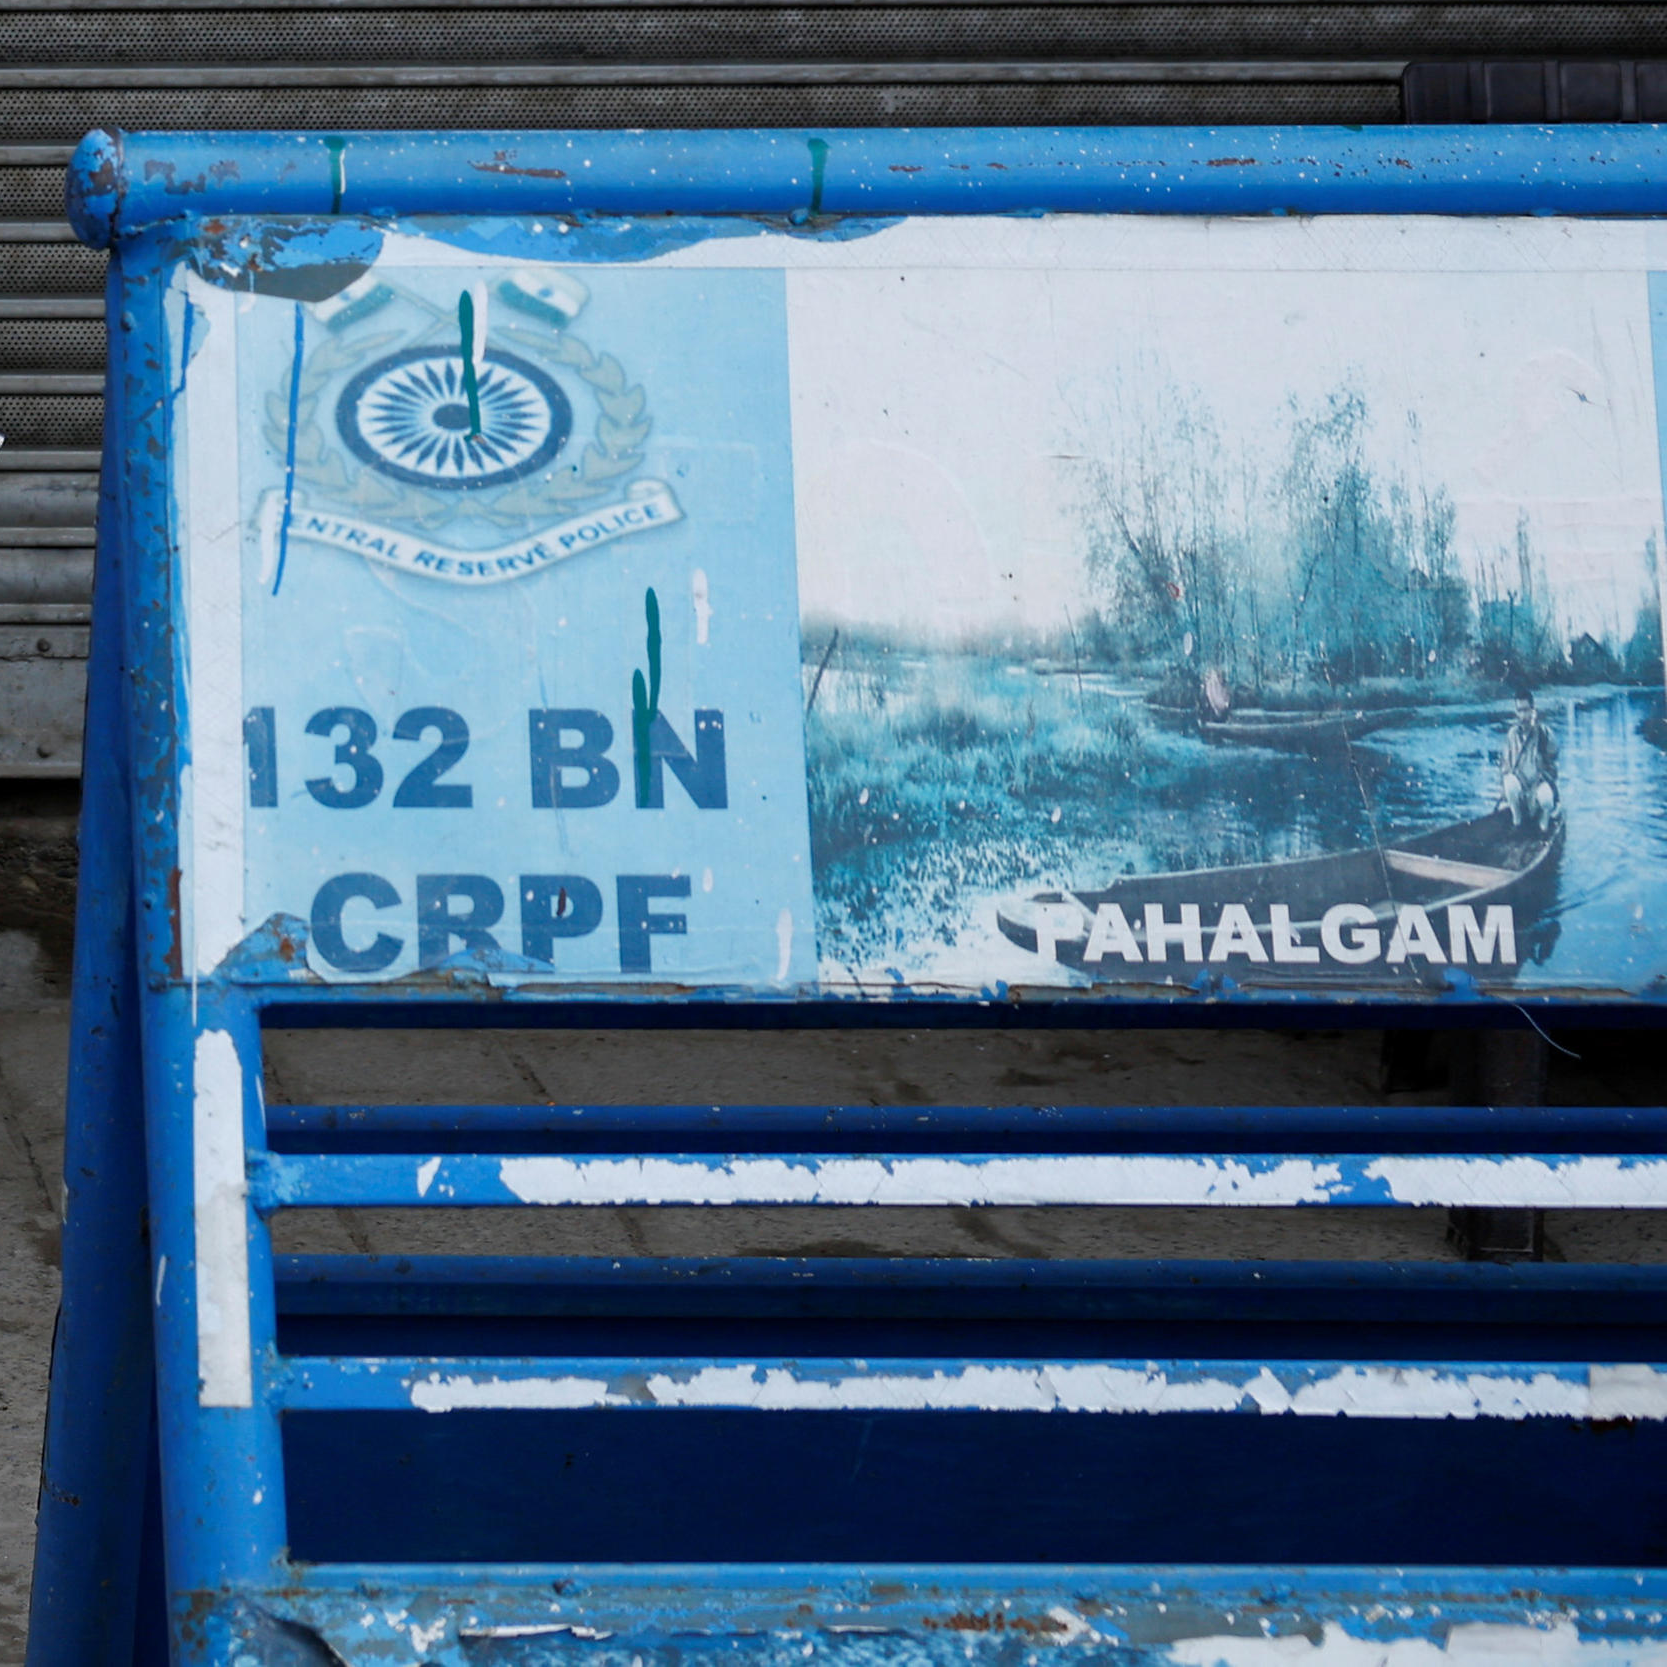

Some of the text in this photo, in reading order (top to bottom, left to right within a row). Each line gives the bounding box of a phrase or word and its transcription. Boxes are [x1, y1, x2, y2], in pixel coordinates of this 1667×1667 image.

[278, 502, 663, 577] ENTRAL RESERVE POLICE
[243, 706, 728, 810] 132 BN
[310, 872, 692, 975] CRPF
[1035, 902, 1518, 966] PAHALGAM
